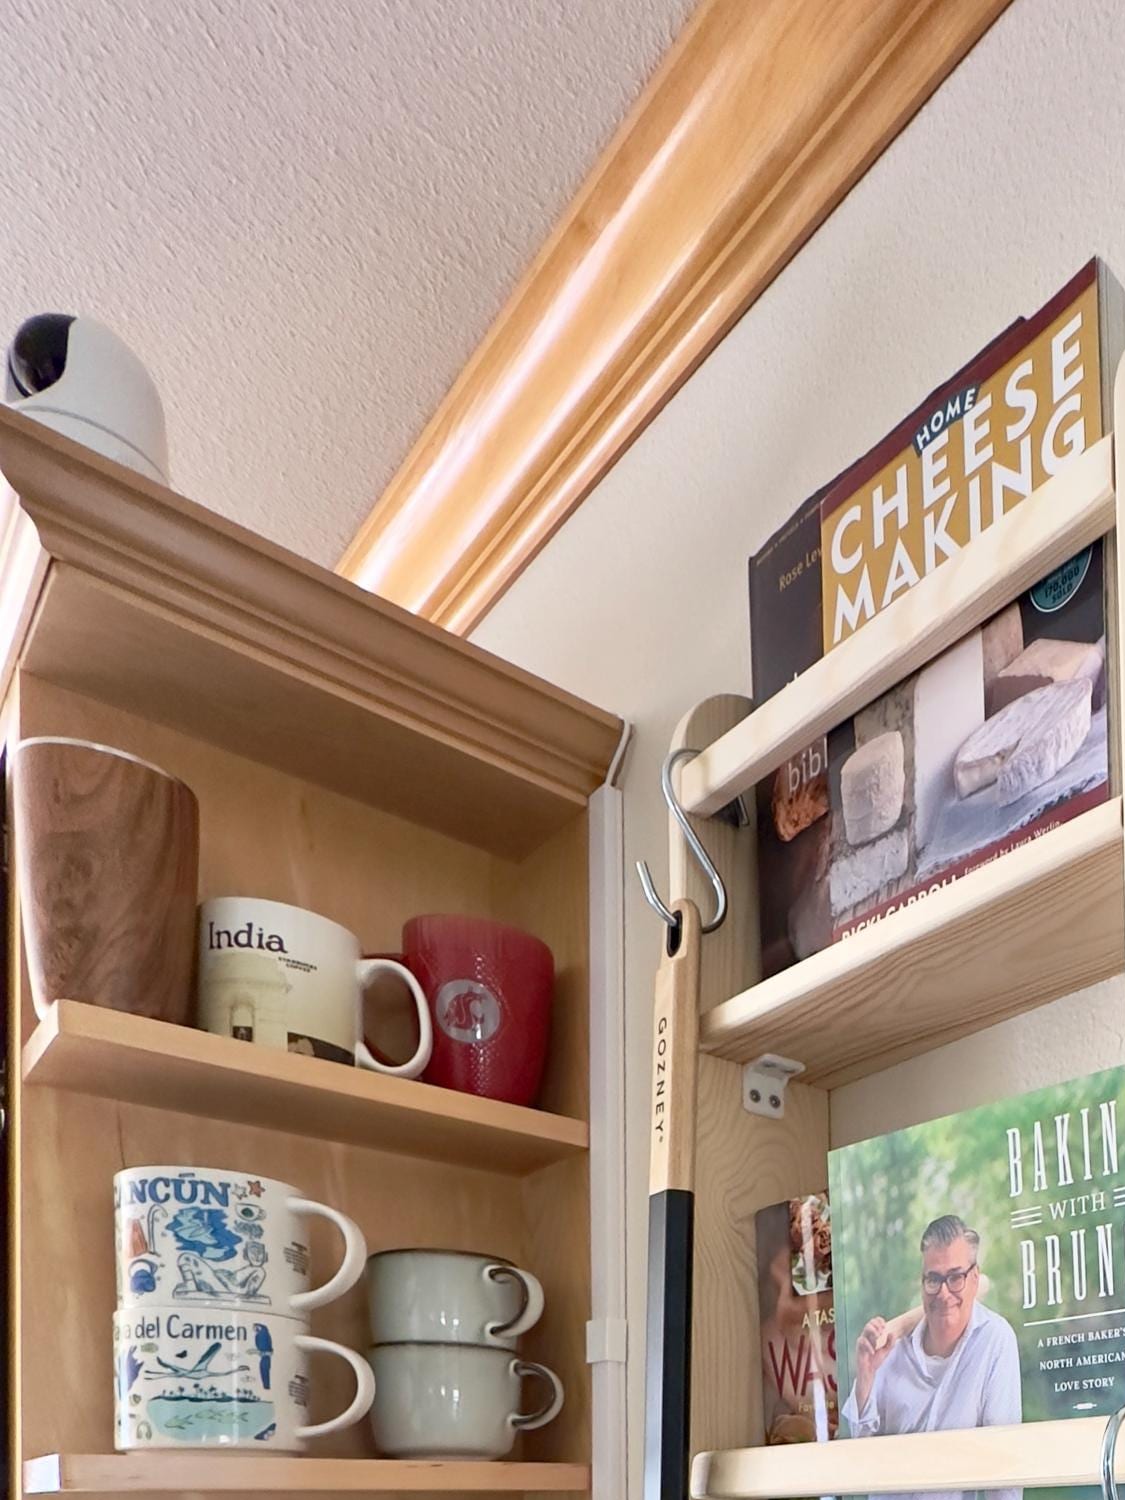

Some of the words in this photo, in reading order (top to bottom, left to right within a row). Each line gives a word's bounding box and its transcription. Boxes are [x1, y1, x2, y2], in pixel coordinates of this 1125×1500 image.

[916, 386, 977, 450] HOME
[830, 311, 1085, 574] CHEESE
[832, 393, 1087, 645] MAKING
[778, 561, 805, 592] Rose
[209, 921, 288, 954] India
[1006, 1100, 1119, 1198] BAKIN
[1049, 1191, 1106, 1221] WITH
[134, 1315, 160, 1340] del
[166, 1313, 248, 1342] Carmen
[801, 1312, 811, 1329] A
[1037, 1338, 1045, 1349] A
[1046, 1332, 1085, 1348] FRENCH
[1039, 1357, 1074, 1372] NORTH
[1054, 1380, 1081, 1393] LOVE
[1082, 1376, 1116, 1391] STORY
